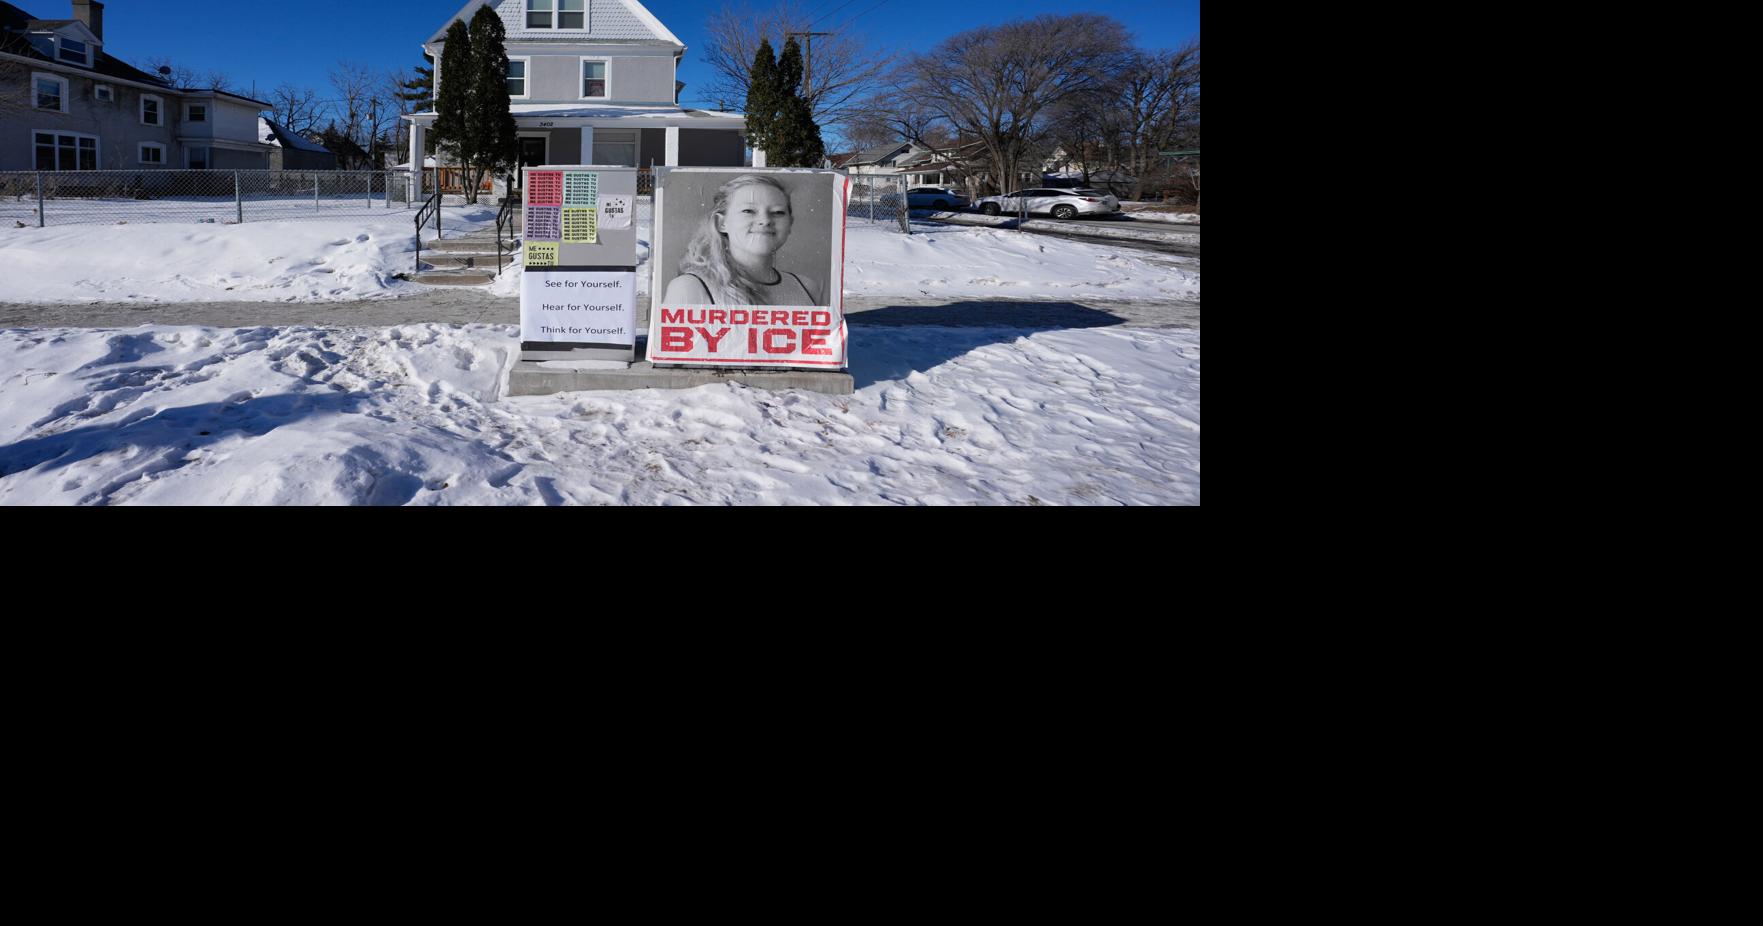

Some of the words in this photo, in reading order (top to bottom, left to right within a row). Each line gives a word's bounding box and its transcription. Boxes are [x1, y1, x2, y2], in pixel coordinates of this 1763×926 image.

[661, 308, 831, 326] MURDERED
[661, 327, 731, 352] BY
[748, 328, 832, 355] ICE
